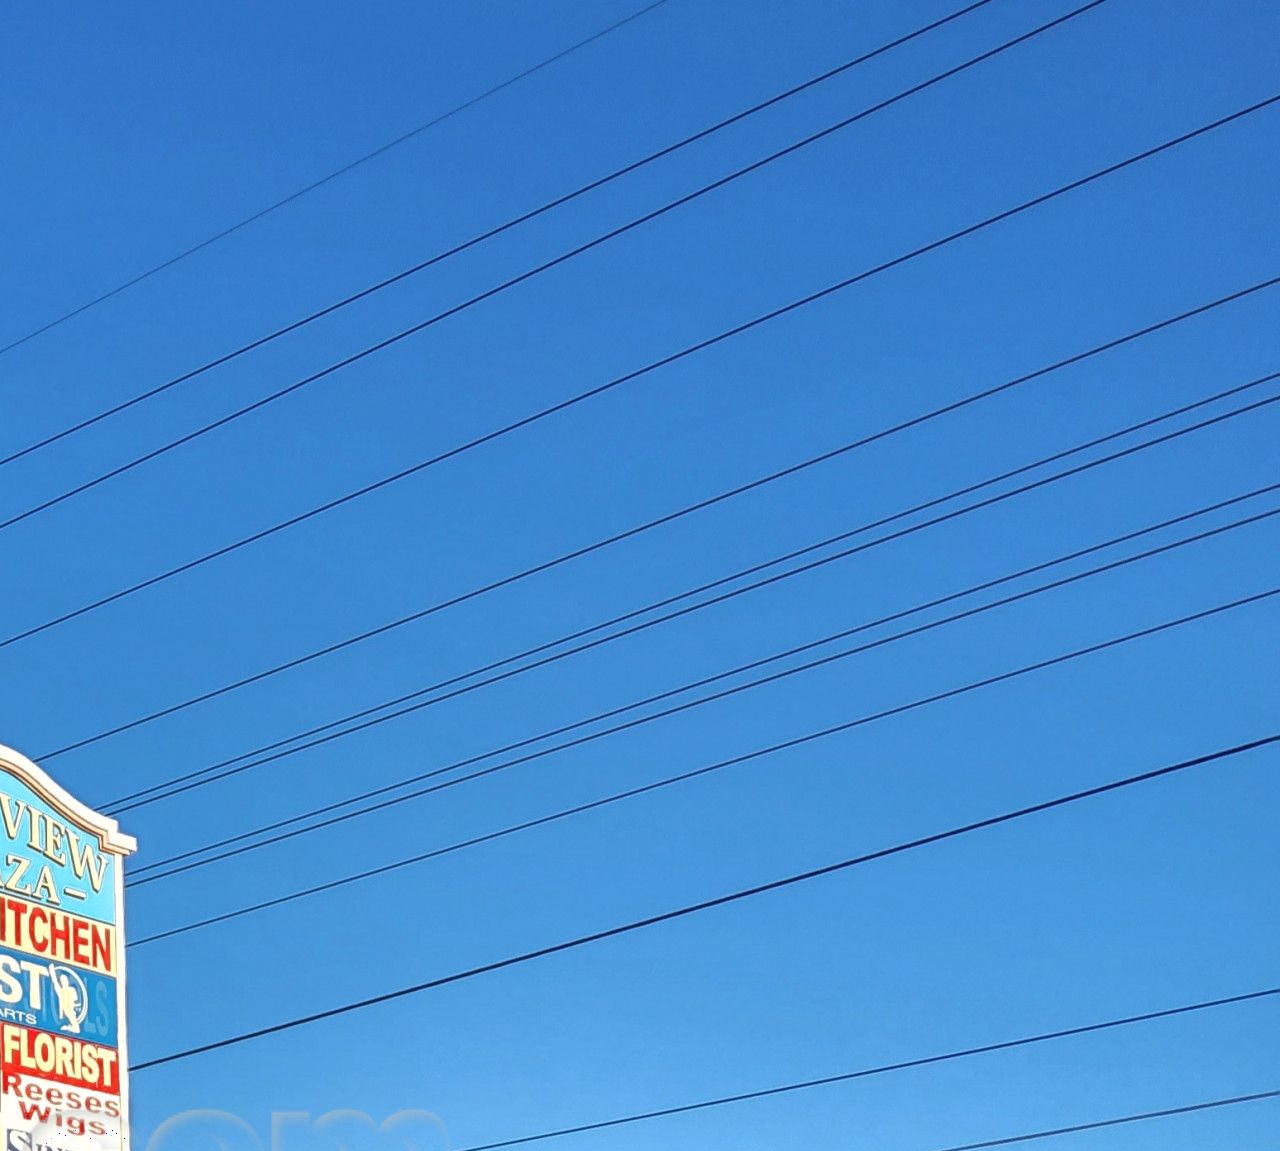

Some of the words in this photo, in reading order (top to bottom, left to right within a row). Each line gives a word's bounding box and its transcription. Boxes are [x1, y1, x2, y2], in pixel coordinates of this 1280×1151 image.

[3, 1023, 117, 1088] FLORIST
[2, 1071, 121, 1118] Reeses
[18, 1100, 107, 1136] Wigs
